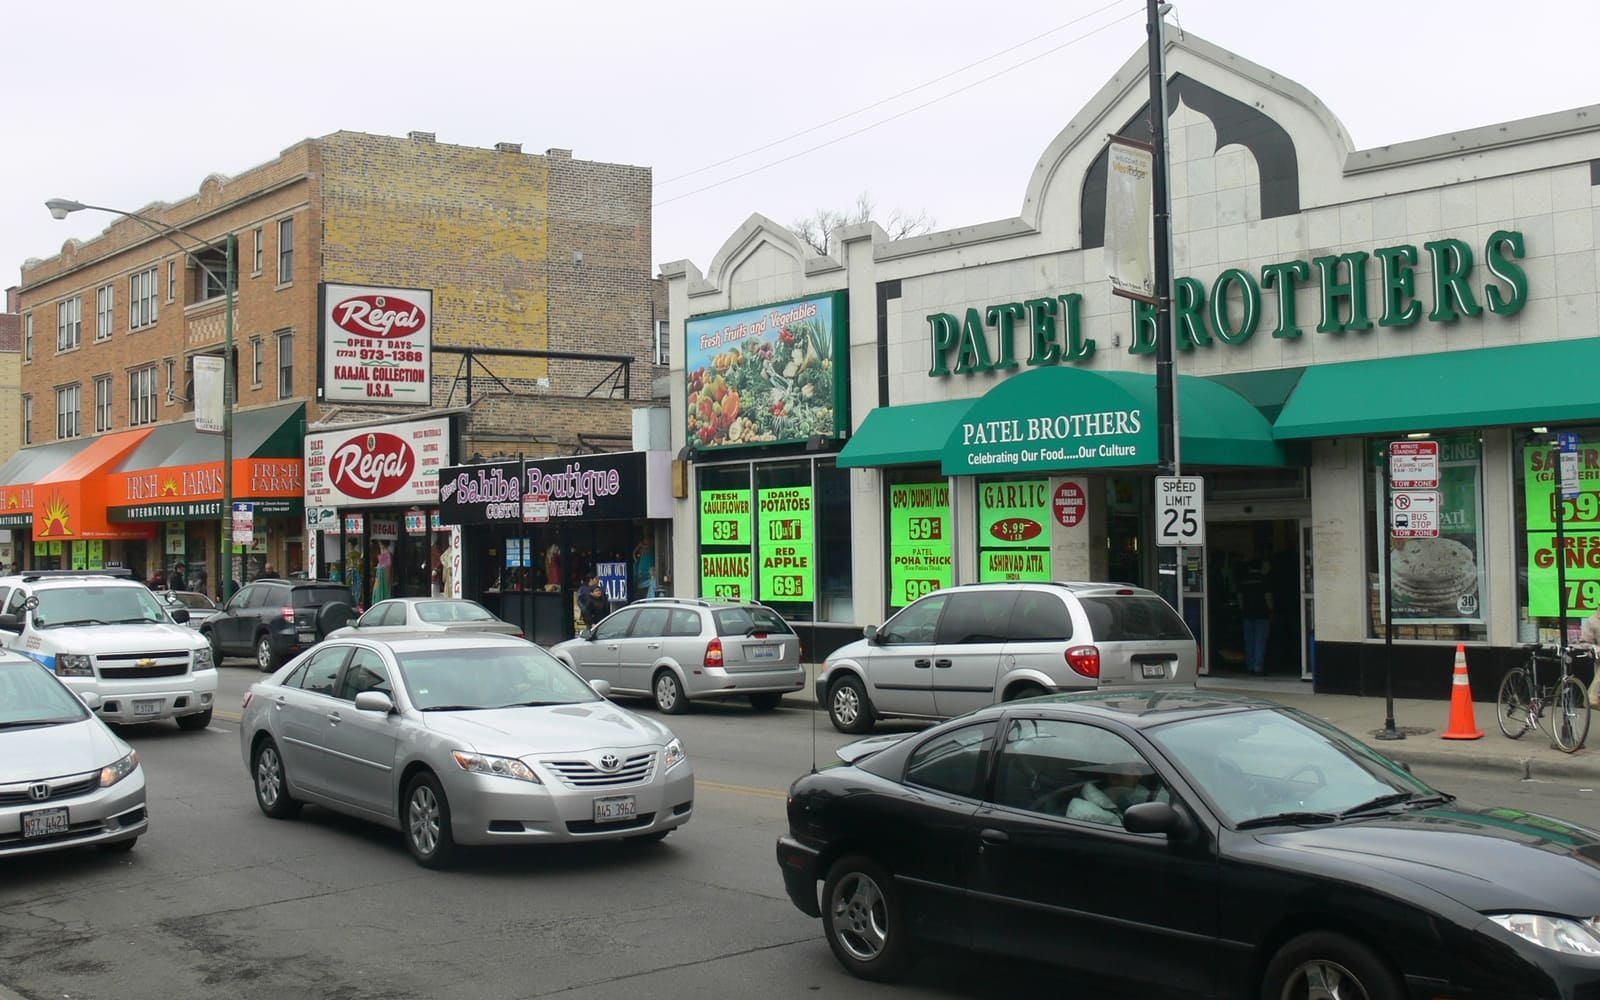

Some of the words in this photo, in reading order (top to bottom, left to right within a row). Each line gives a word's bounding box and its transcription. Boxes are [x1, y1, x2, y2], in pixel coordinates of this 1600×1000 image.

[927, 293, 1095, 377] PATEL
[1128, 230, 1528, 354] BROTHERS
[339, 300, 419, 336] Regal
[699, 334, 721, 349] Fresh
[723, 324, 747, 341] Fruits
[750, 316, 767, 336] and
[769, 303, 817, 329] Vegetables
[347, 339, 373, 348] OPEN
[377, 340, 383, 348] 7
[388, 341, 412, 349] DAYS
[336, 349, 356, 358] (773)
[334, 366, 369, 380] KAAJAL
[373, 367, 425, 383] COLLECTION
[366, 383, 393, 398] U.S.A.
[963, 420, 1023, 445] PATEL
[1027, 410, 1141, 441] BROTHERS
[967, 451, 1019, 465] Celebrating
[1021, 450, 1038, 462] Our
[1099, 443, 1136, 457] Culture
[254, 464, 299, 477] FRESH
[334, 443, 407, 494] Regal
[127, 474, 158, 499] FRESH
[182, 468, 223, 496] FARMS
[252, 478, 302, 491] FARMS
[456, 468, 519, 504] Sahiba
[527, 462, 620, 506] Boutique
[1163, 481, 1196, 492] SPEED
[984, 484, 1046, 509] GARLIC
[1165, 496, 1192, 506] LIMIT
[127, 505, 185, 518] INTERNATIONAL
[189, 503, 220, 515] MARKET
[486, 502, 519, 519] COSTU
[548, 500, 585, 517] WELRY
[703, 500, 749, 514] CAULIFLOWER
[760, 498, 810, 512] POTATOES
[1163, 509, 1197, 537] 25
[1411, 513, 1428, 521] BUS
[373, 523, 397, 535] REGAL
[775, 547, 796, 555] RED
[703, 557, 749, 578] BANANAS
[764, 557, 807, 568] APPLE
[895, 556, 921, 565] POHA
[924, 556, 951, 565] THICK
[989, 554, 1024, 572] ASHIRVAD
[1026, 554, 1044, 572] ATTA
[1461, 595, 1474, 606] 30
